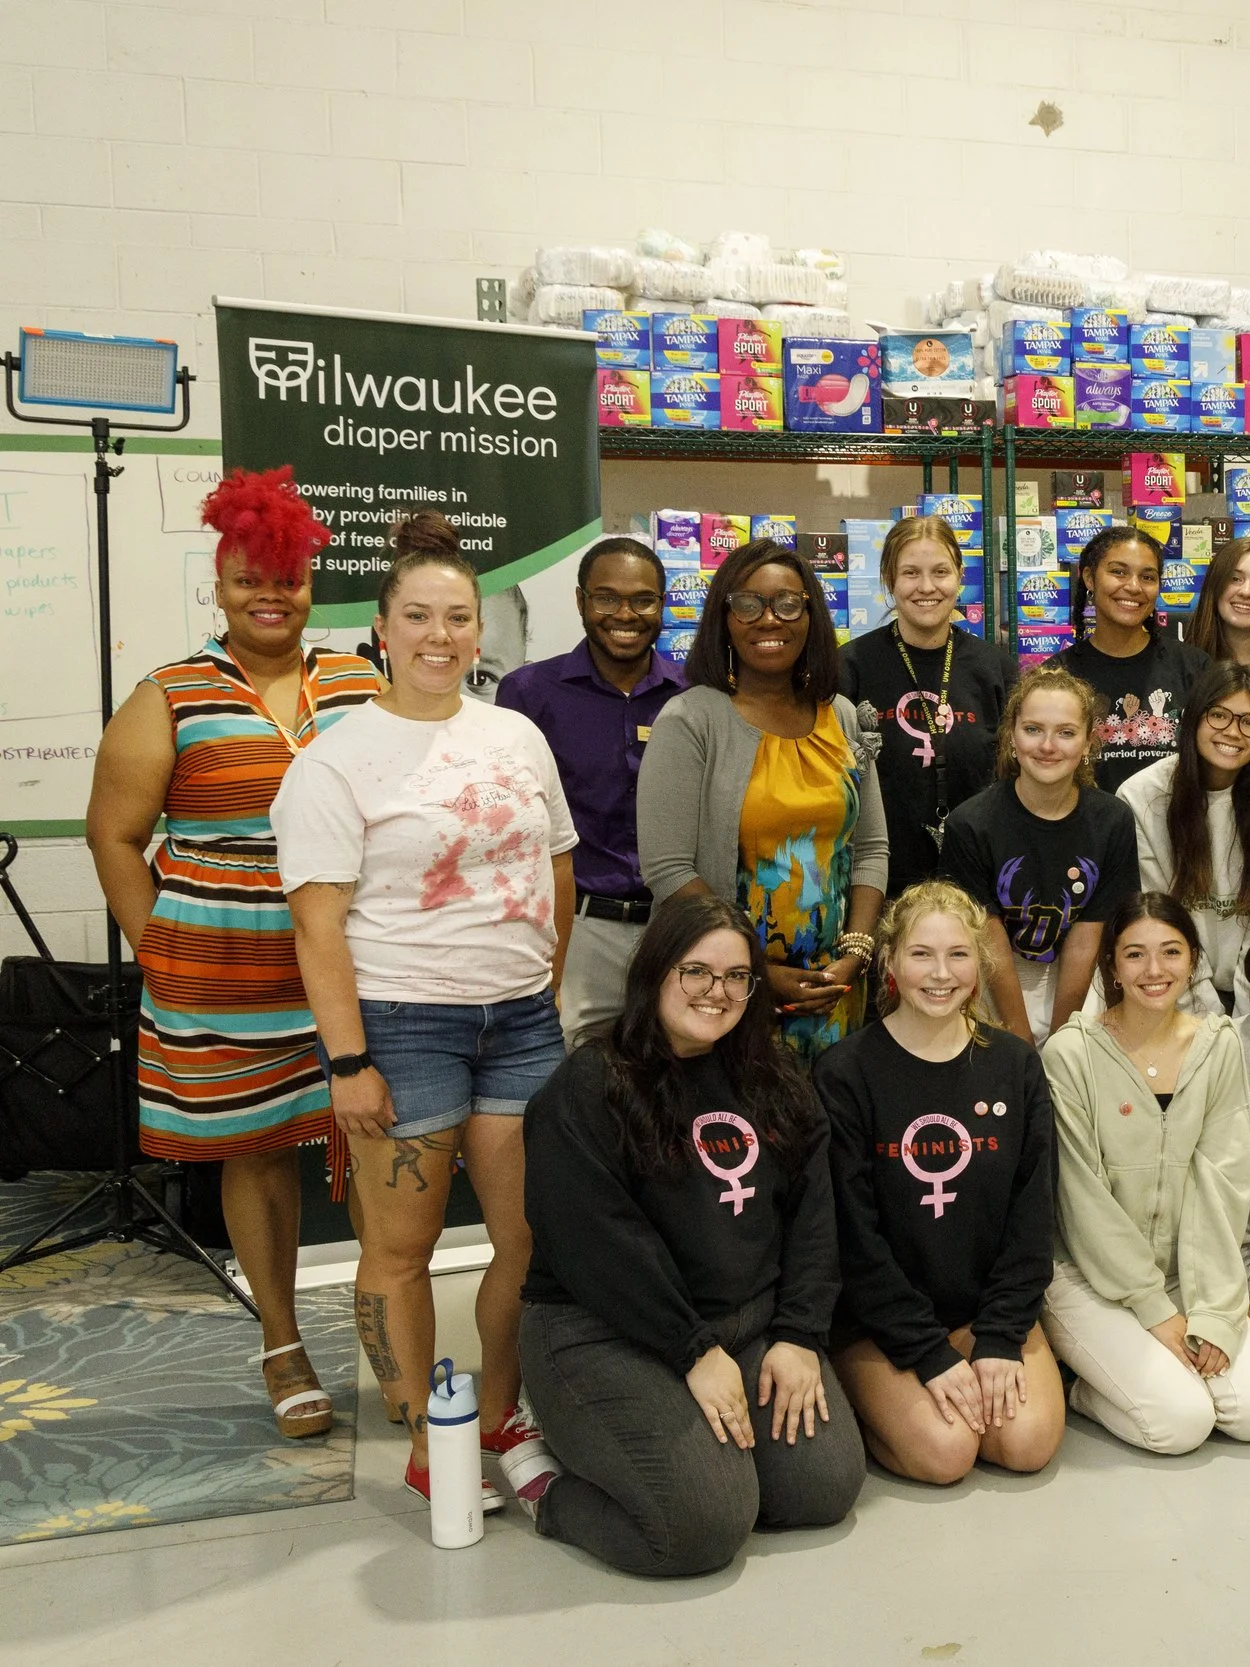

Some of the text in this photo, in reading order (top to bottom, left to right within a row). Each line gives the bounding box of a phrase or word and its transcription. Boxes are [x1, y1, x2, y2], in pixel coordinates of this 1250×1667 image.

[599, 331, 639, 343] MPAX
[1082, 328, 1118, 337] TAMPAX
[664, 335, 707, 345] TAMPAX
[1024, 340, 1062, 350] TAMPAX
[734, 342, 768, 355] SPORT
[1142, 344, 1178, 354] TAMPAX
[796, 365, 822, 376] Maxi
[1086, 381, 1122, 400] always
[600, 393, 635, 406] SPORT
[664, 393, 707, 403] TAMPAX
[1031, 397, 1061, 409] SPORT
[1142, 398, 1179, 408] TAMPAX
[735, 399, 769, 412] SPORT
[909, 402, 917, 412] U
[964, 404, 973, 414] U
[1200, 401, 1236, 411] TAMPAX
[324, 415, 558, 458] diaper mission
[1076, 474, 1085, 484] U
[1144, 475, 1173, 487] SPORT
[378, 484, 468, 503] families in
[312, 507, 508, 528] by providin reliable
[1144, 508, 1173, 519] Breeze
[670, 525, 694, 533] always
[1184, 527, 1204, 536] Veeda
[1218, 522, 1226, 532] U
[329, 532, 346, 547] of
[350, 532, 386, 548] free
[459, 537, 493, 551] and
[774, 536, 794, 545] PAX
[818, 536, 827, 546] U
[0, 546, 56, 569] apers
[325, 557, 393, 575] supplie
[6, 573, 78, 597] products
[1022, 591, 1058, 601] TAMPAX
[4, 602, 55, 618] wipes
[1020, 636, 1061, 647] TAMPAX
[944, 639, 953, 672] OSHKOSH
[942, 671, 950, 683] UW
[0, 747, 95, 761] ISTRIBUTED
[1104, 749, 1137, 761] period
[462, 797, 480, 812] Let
[717, 1113, 737, 1125] ALL BE
[911, 1115, 959, 1131] WE SHOULD ALL BE
[696, 1132, 756, 1153] MINIS
[876, 1136, 999, 1158] FEMINISTS
